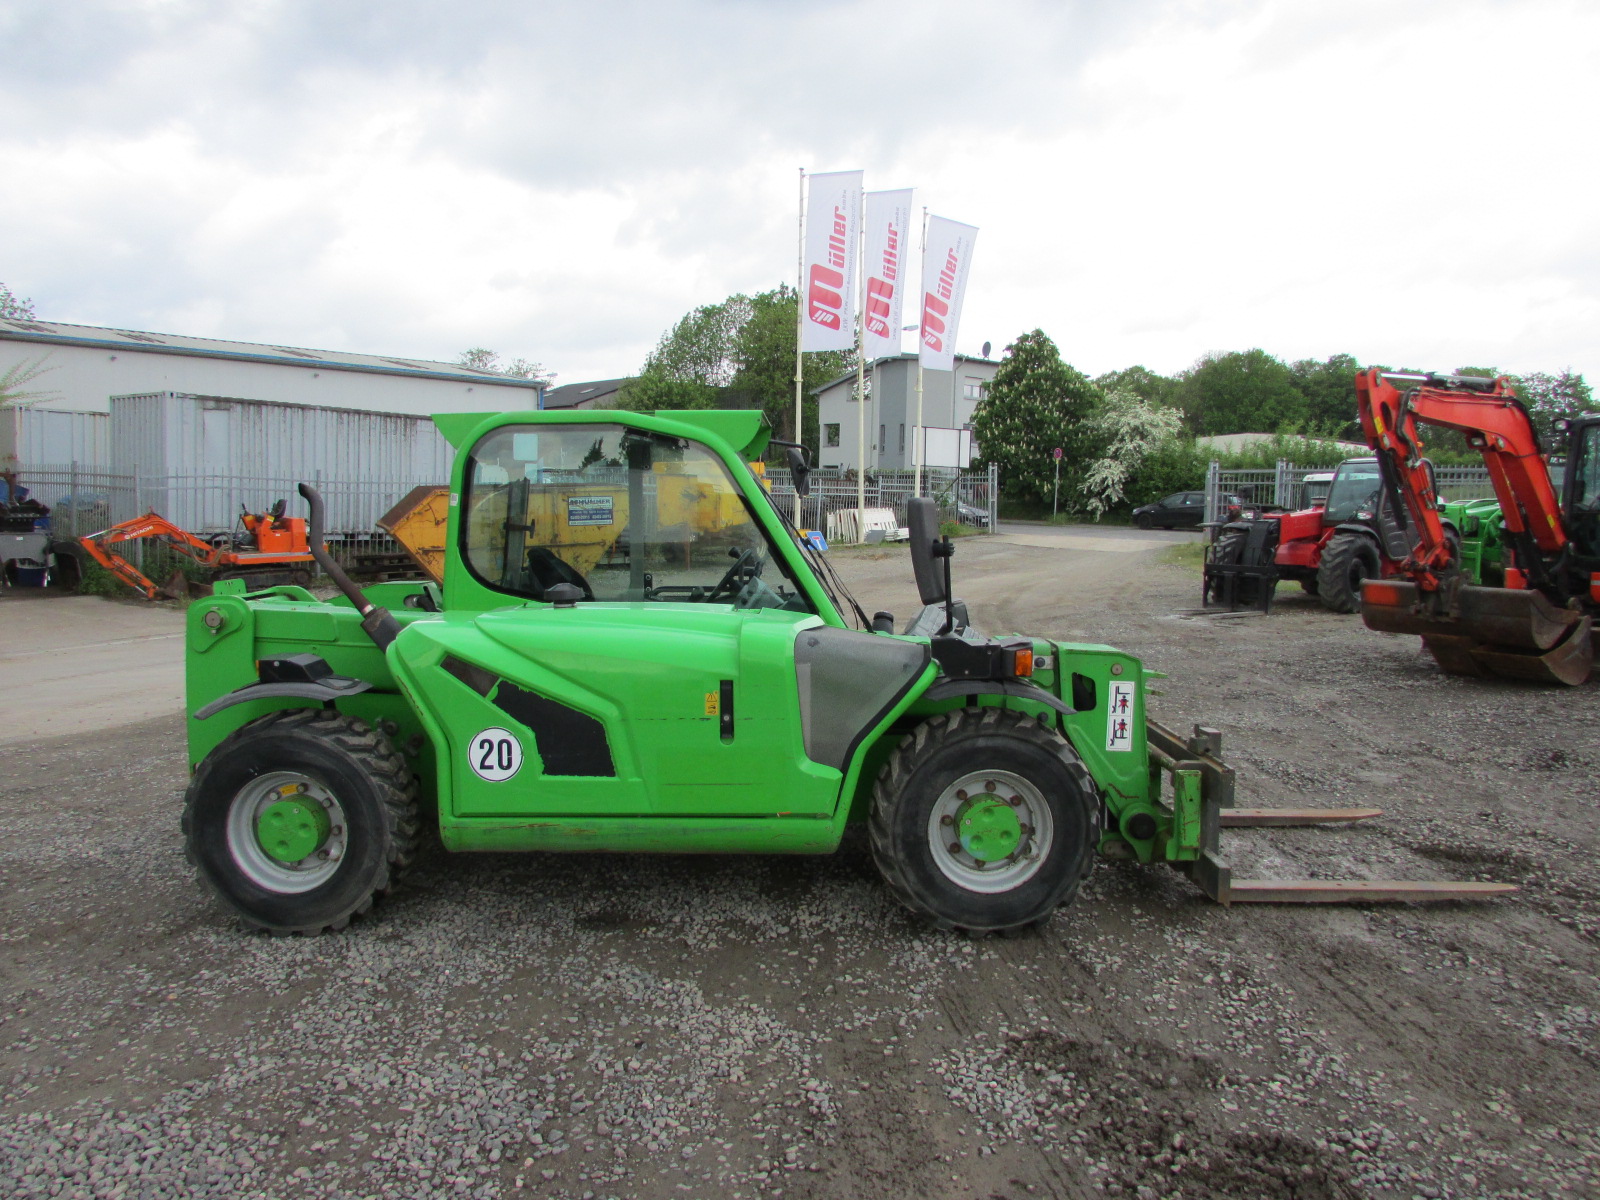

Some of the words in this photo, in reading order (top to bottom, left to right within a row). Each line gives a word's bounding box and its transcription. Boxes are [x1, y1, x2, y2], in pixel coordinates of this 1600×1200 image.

[808, 205, 847, 331] Müller
[865, 222, 898, 339] Müller
[479, 738, 513, 771] 20
